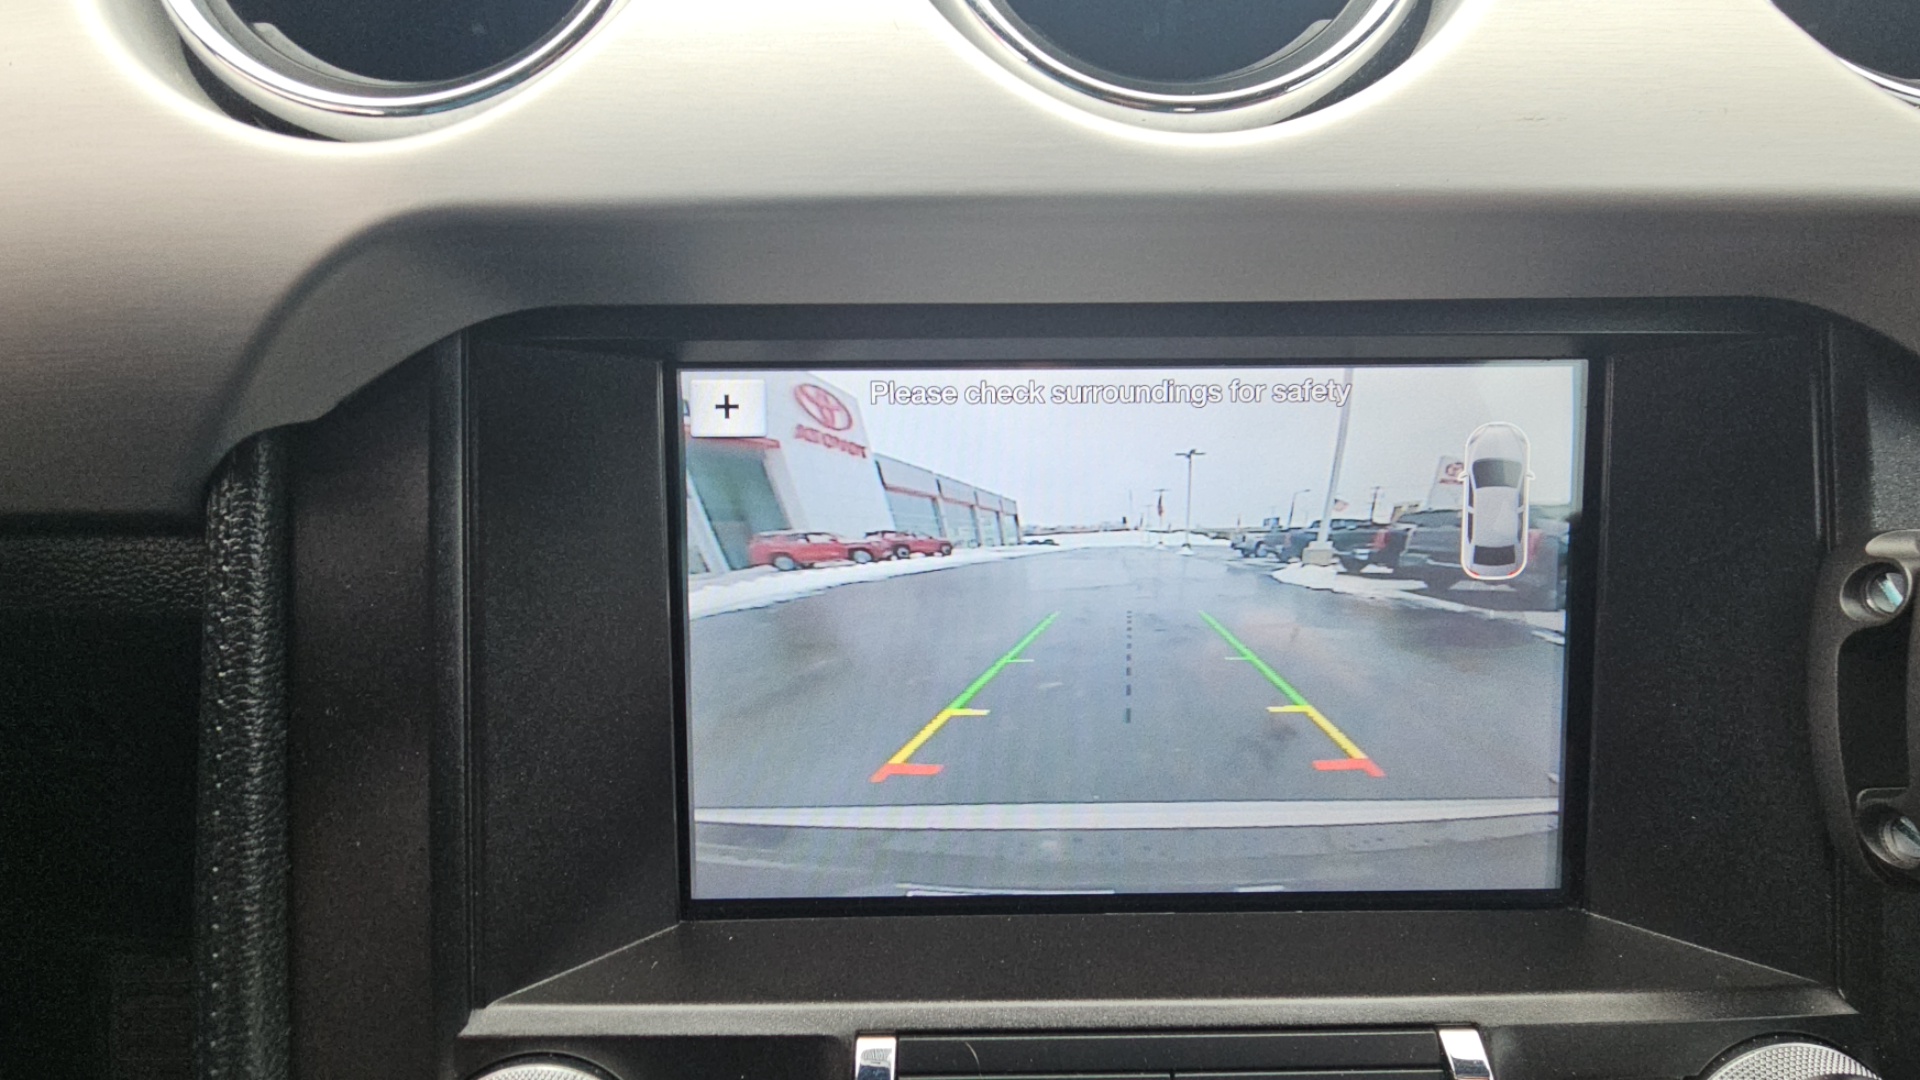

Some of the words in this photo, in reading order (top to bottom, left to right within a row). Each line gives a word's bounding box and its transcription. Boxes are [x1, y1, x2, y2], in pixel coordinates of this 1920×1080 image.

[869, 380, 958, 405] Please
[964, 379, 1045, 405] check
[1050, 378, 1222, 408] surroundings
[1229, 378, 1267, 403] for
[1271, 377, 1352, 407] safety
